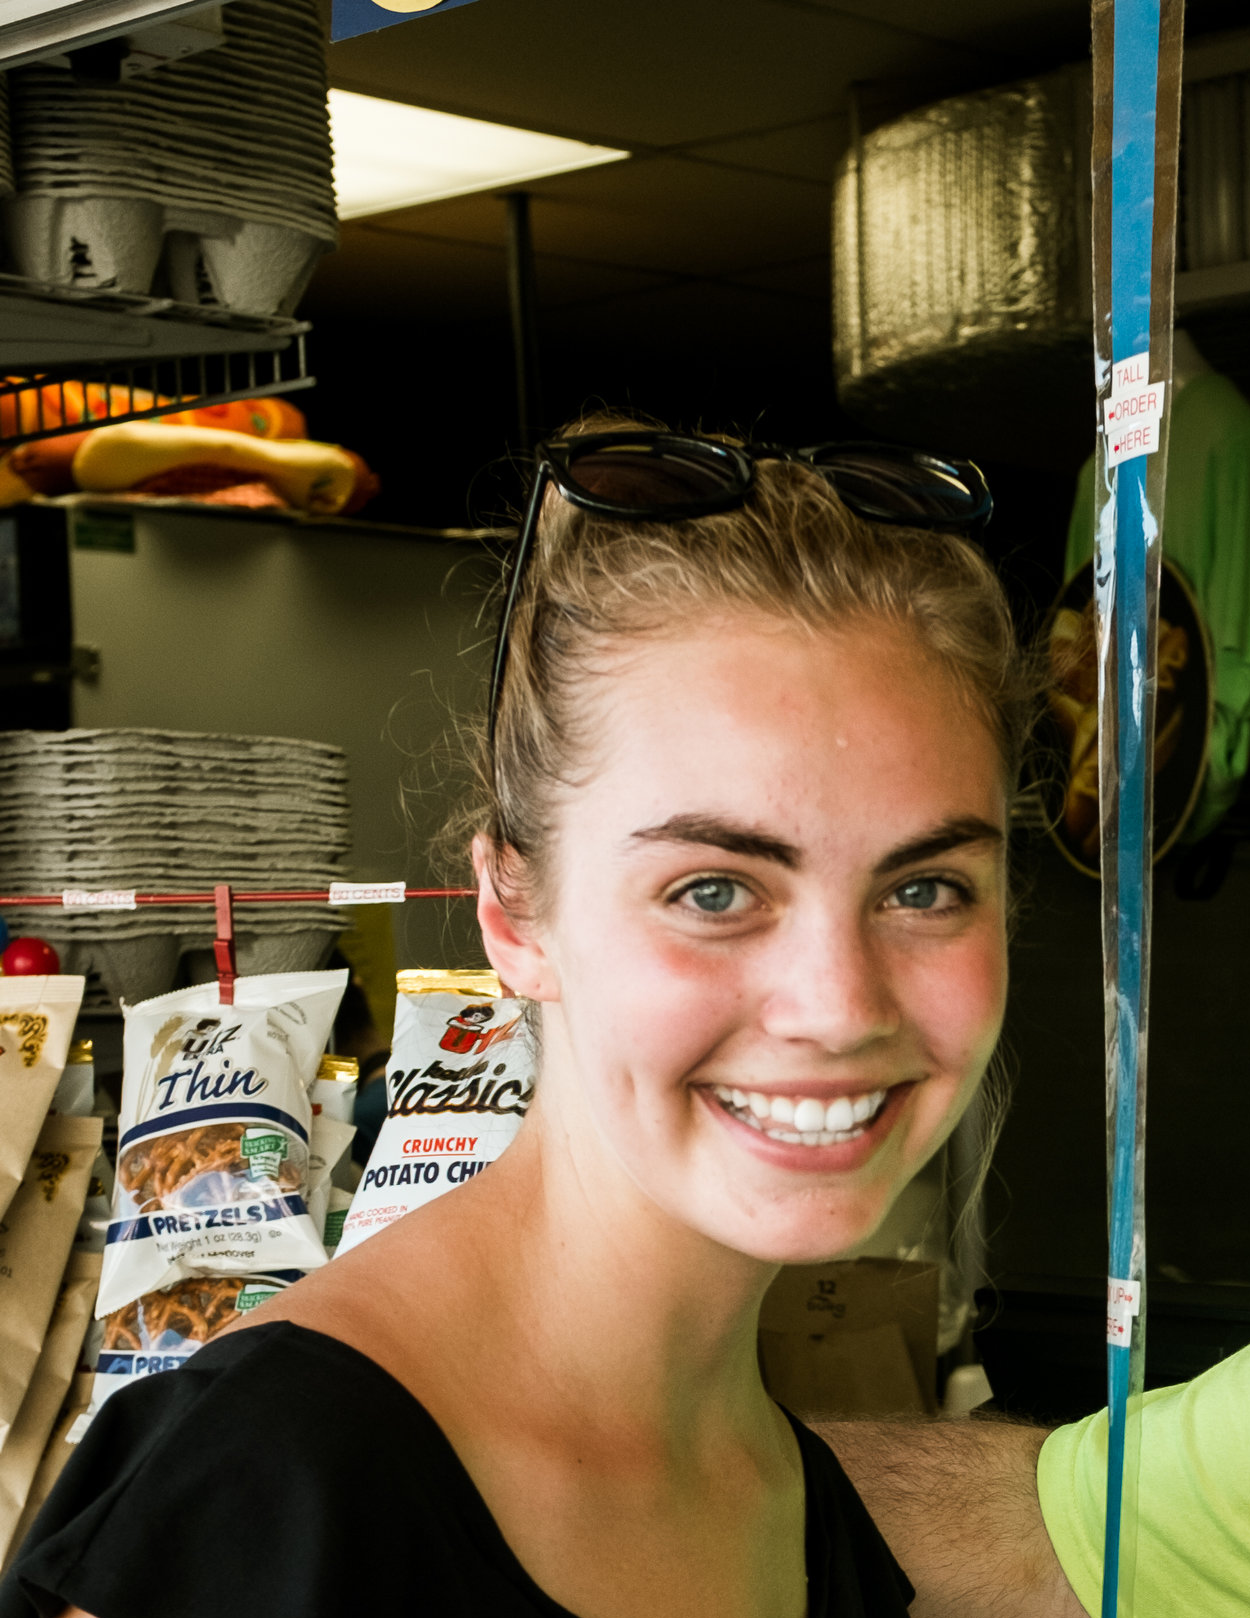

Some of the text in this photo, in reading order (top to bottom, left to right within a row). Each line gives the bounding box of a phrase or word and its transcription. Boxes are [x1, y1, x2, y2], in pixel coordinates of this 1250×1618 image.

[1117, 362, 1144, 388] TALL
[1114, 391, 1157, 420] ORDER
[1119, 426, 1151, 454] HERE
[355, 886, 402, 900] CENTS
[158, 1060, 268, 1112] Thin
[402, 1137, 479, 1154] CRUNCHY
[363, 1160, 497, 1192] POTATO CHI
[153, 1204, 264, 1235] PRETZELS
